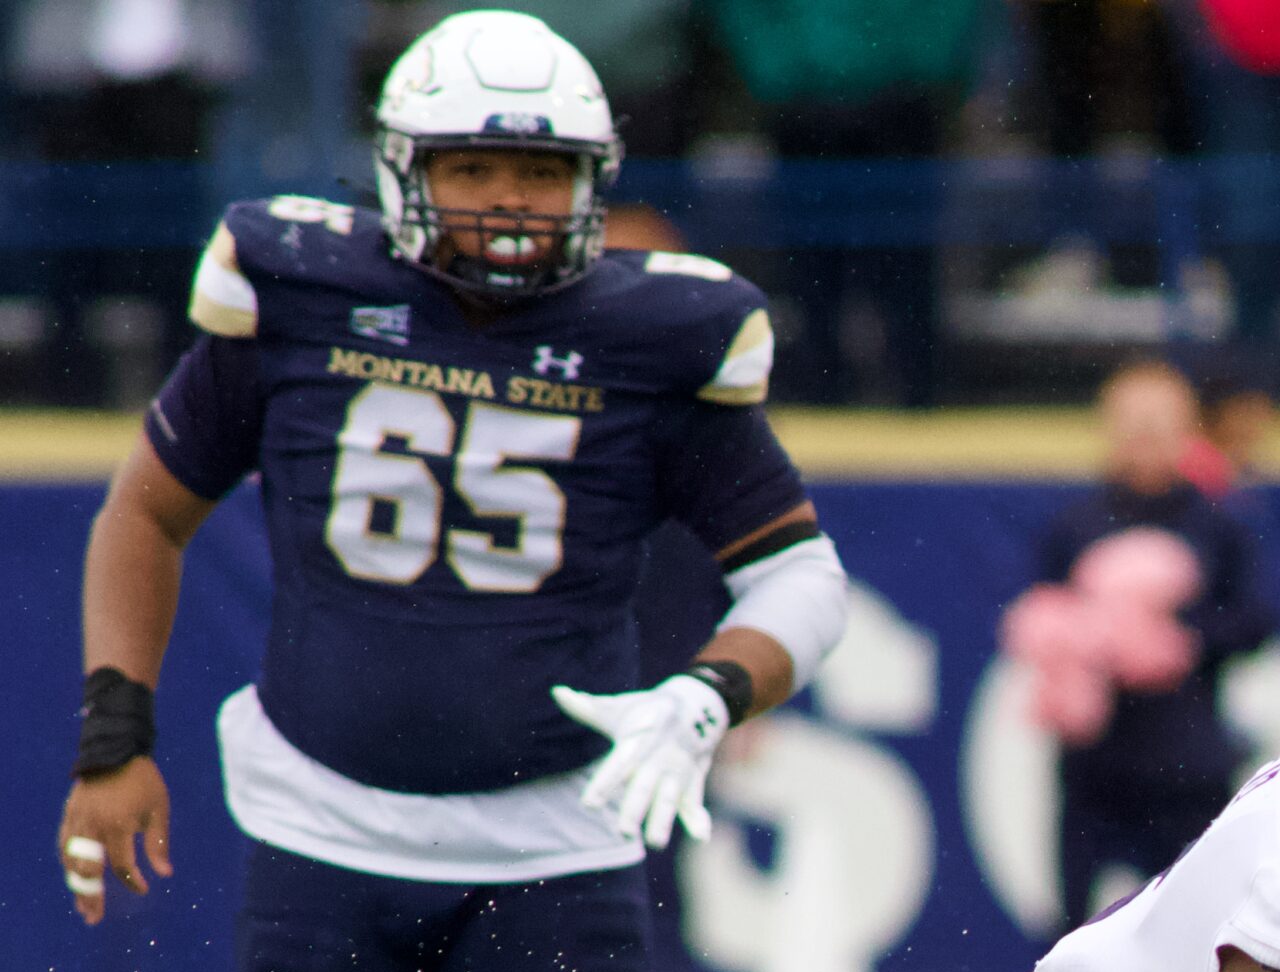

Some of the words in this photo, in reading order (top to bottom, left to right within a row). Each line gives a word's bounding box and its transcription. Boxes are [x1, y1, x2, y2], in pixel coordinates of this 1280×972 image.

[326, 347, 496, 399] MONTANA
[506, 376, 605, 413] STATE
[325, 382, 583, 593] 65
